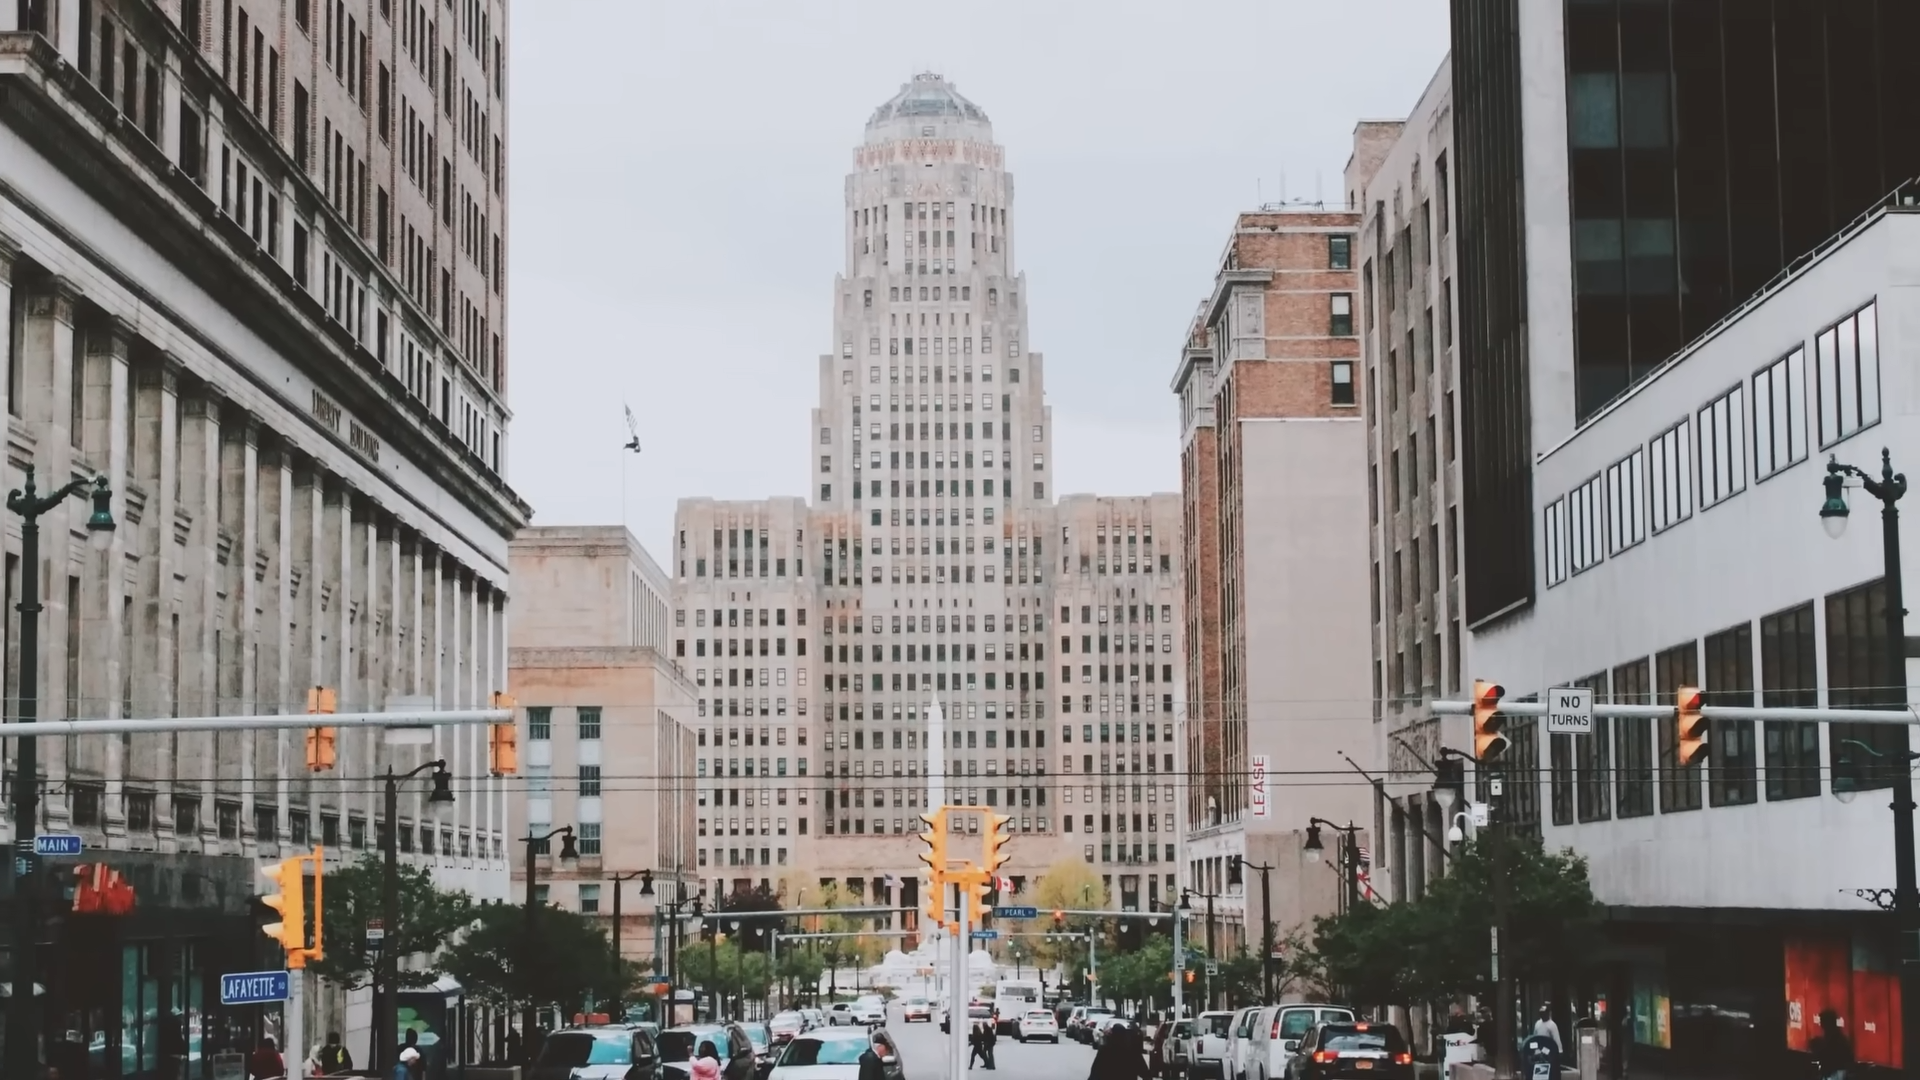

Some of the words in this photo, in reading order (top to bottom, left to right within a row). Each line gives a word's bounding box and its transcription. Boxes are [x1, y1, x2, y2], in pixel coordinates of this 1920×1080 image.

[311, 388, 341, 433] LIBERTY
[349, 419, 380, 463] BUILDING
[1560, 696, 1580, 708] NO
[1551, 714, 1589, 726] TURNS
[1253, 756, 1265, 816] LEASE
[37, 839, 69, 852] MAIN
[1004, 908, 1026, 917] PEARL
[222, 976, 276, 999] LAFAYETTE
